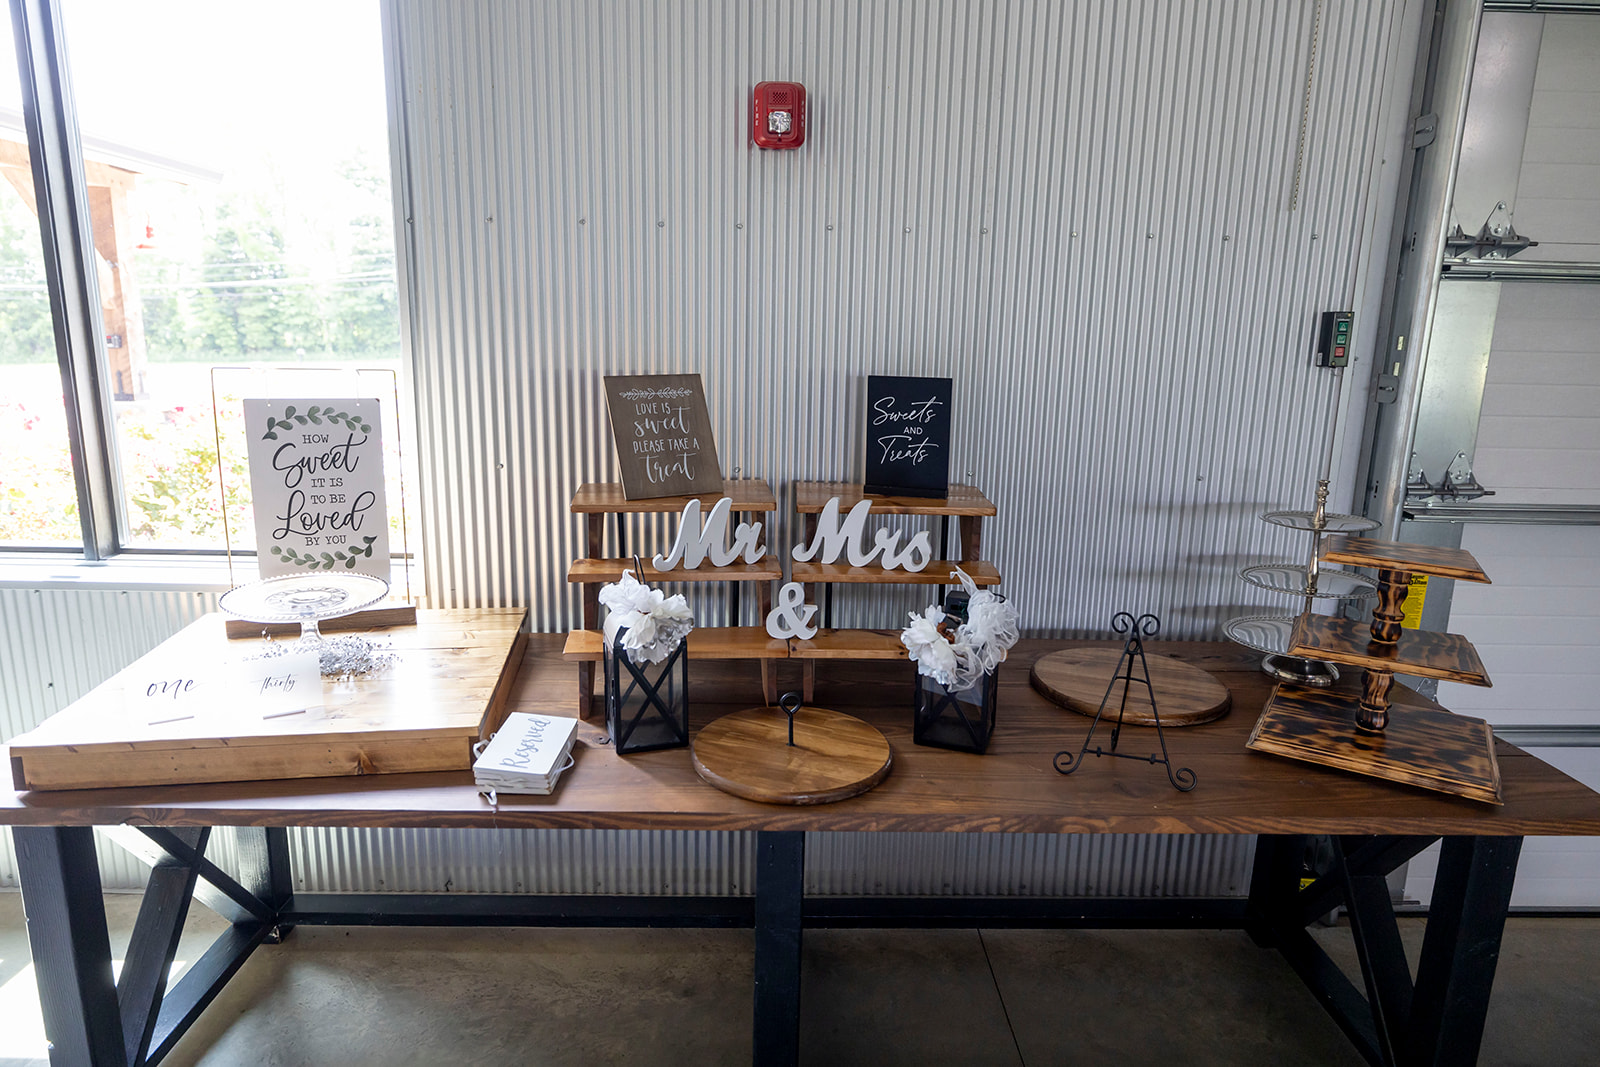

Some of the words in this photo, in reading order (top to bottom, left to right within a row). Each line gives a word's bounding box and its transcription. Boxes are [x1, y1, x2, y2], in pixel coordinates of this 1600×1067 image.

[634, 406, 691, 437] sweet
[636, 402, 658, 415] LOVE
[661, 402, 671, 414] IS
[873, 396, 943, 426] Sweets
[302, 434, 329, 443] HOW
[633, 438, 665, 454] PLEASE
[668, 437, 689, 451] TAKE
[693, 437, 700, 450] A
[903, 426, 923, 435] AND
[273, 433, 368, 488] Sweet
[878, 435, 939, 466] Treats
[311, 478, 325, 487] IT
[330, 477, 343, 487] IS
[639, 452, 697, 484] treat
[311, 494, 326, 504] TO
[329, 494, 346, 504] BE
[272, 490, 376, 540] Loved
[305, 537, 320, 546] BY
[325, 535, 347, 545] YOU
[652, 497, 767, 572] Mr
[792, 497, 932, 573] Mrs
[766, 581, 819, 641] &
[146, 678, 200, 700] one
[251, 673, 298, 696] thirty
[499, 717, 551, 769] Reserved
